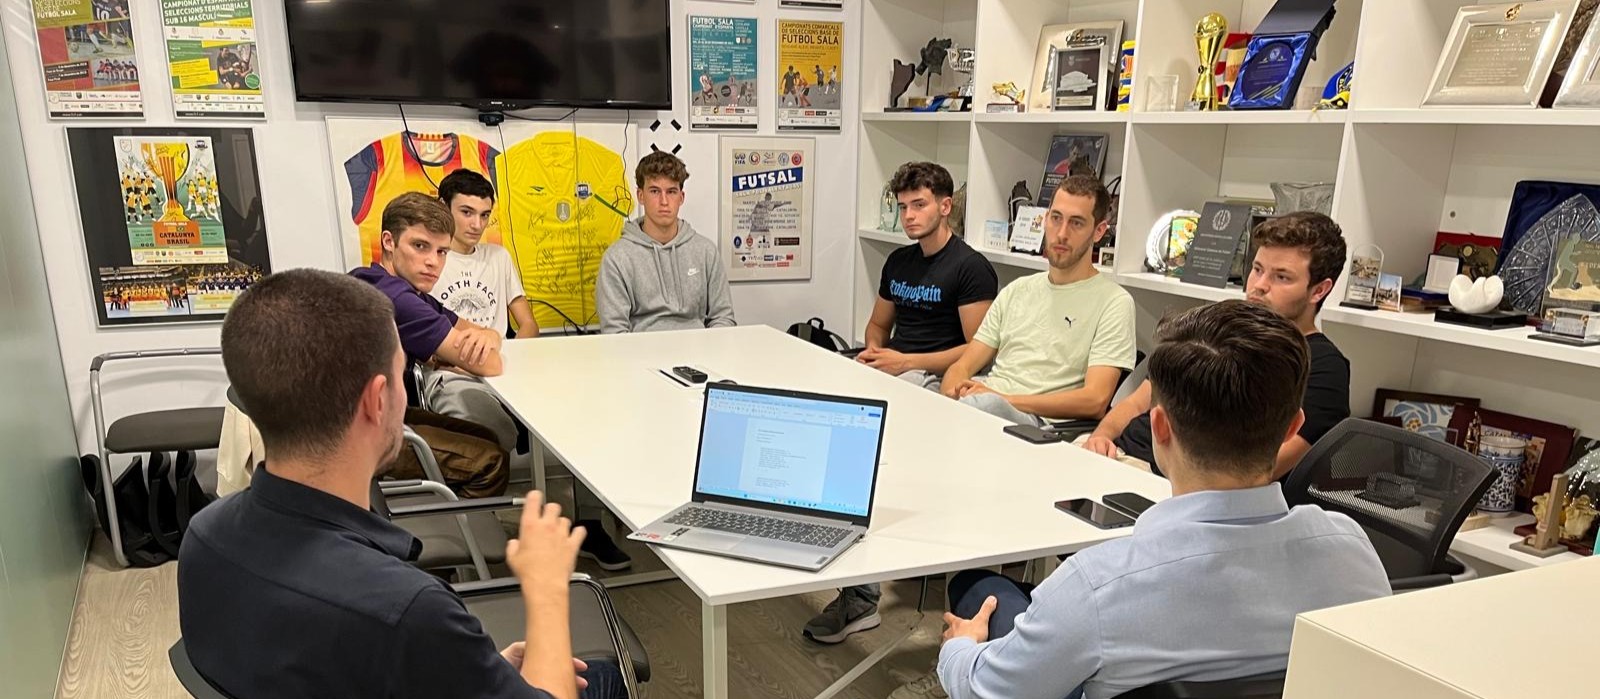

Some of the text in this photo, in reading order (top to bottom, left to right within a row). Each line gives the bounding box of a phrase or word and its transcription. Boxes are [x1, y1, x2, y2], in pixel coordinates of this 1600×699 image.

[37, 11, 60, 19] FUTBOL
[164, 1, 249, 17] SELECCIONS TERRITORIALS
[165, 17, 179, 25] SUB
[179, 15, 188, 23] 16
[692, 17, 734, 26] FUTBOL SALA
[781, 33, 840, 45] FUTBOL SALA
[738, 169, 797, 190] FUTSAL
[441, 280, 497, 307] ORTH FACE
